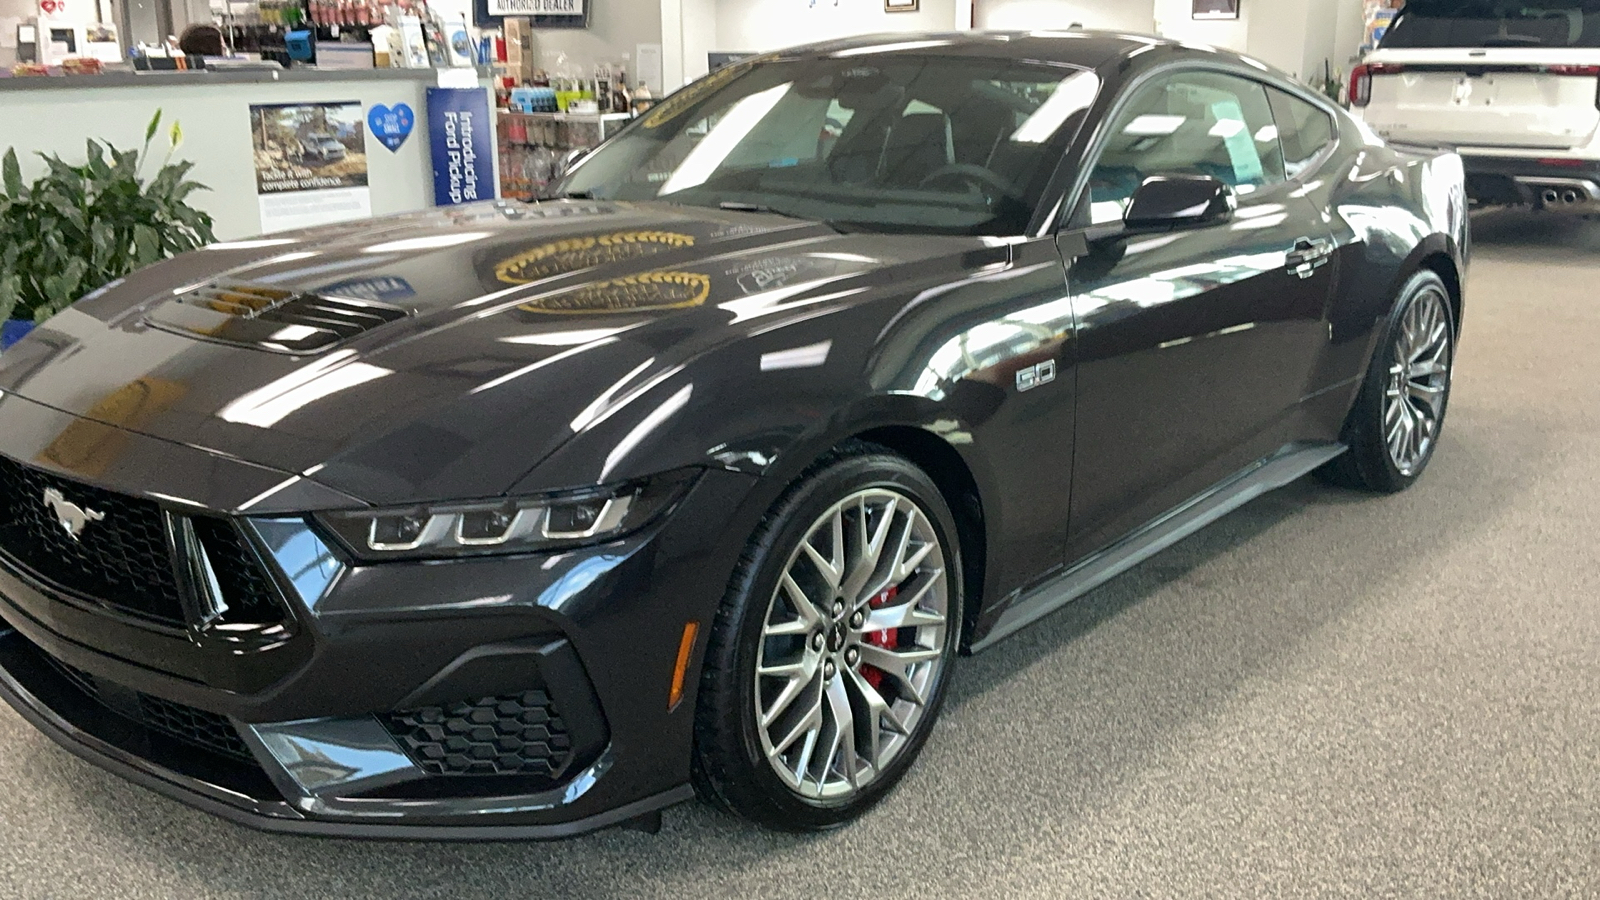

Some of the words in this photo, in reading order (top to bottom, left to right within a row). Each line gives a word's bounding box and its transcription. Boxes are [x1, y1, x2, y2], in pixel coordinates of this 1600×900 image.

[543, 0, 574, 12] DEALER
[444, 111, 461, 149] Ford
[460, 111, 478, 200] Introducing
[261, 180, 299, 192] complete
[447, 150, 463, 204] Pickup
